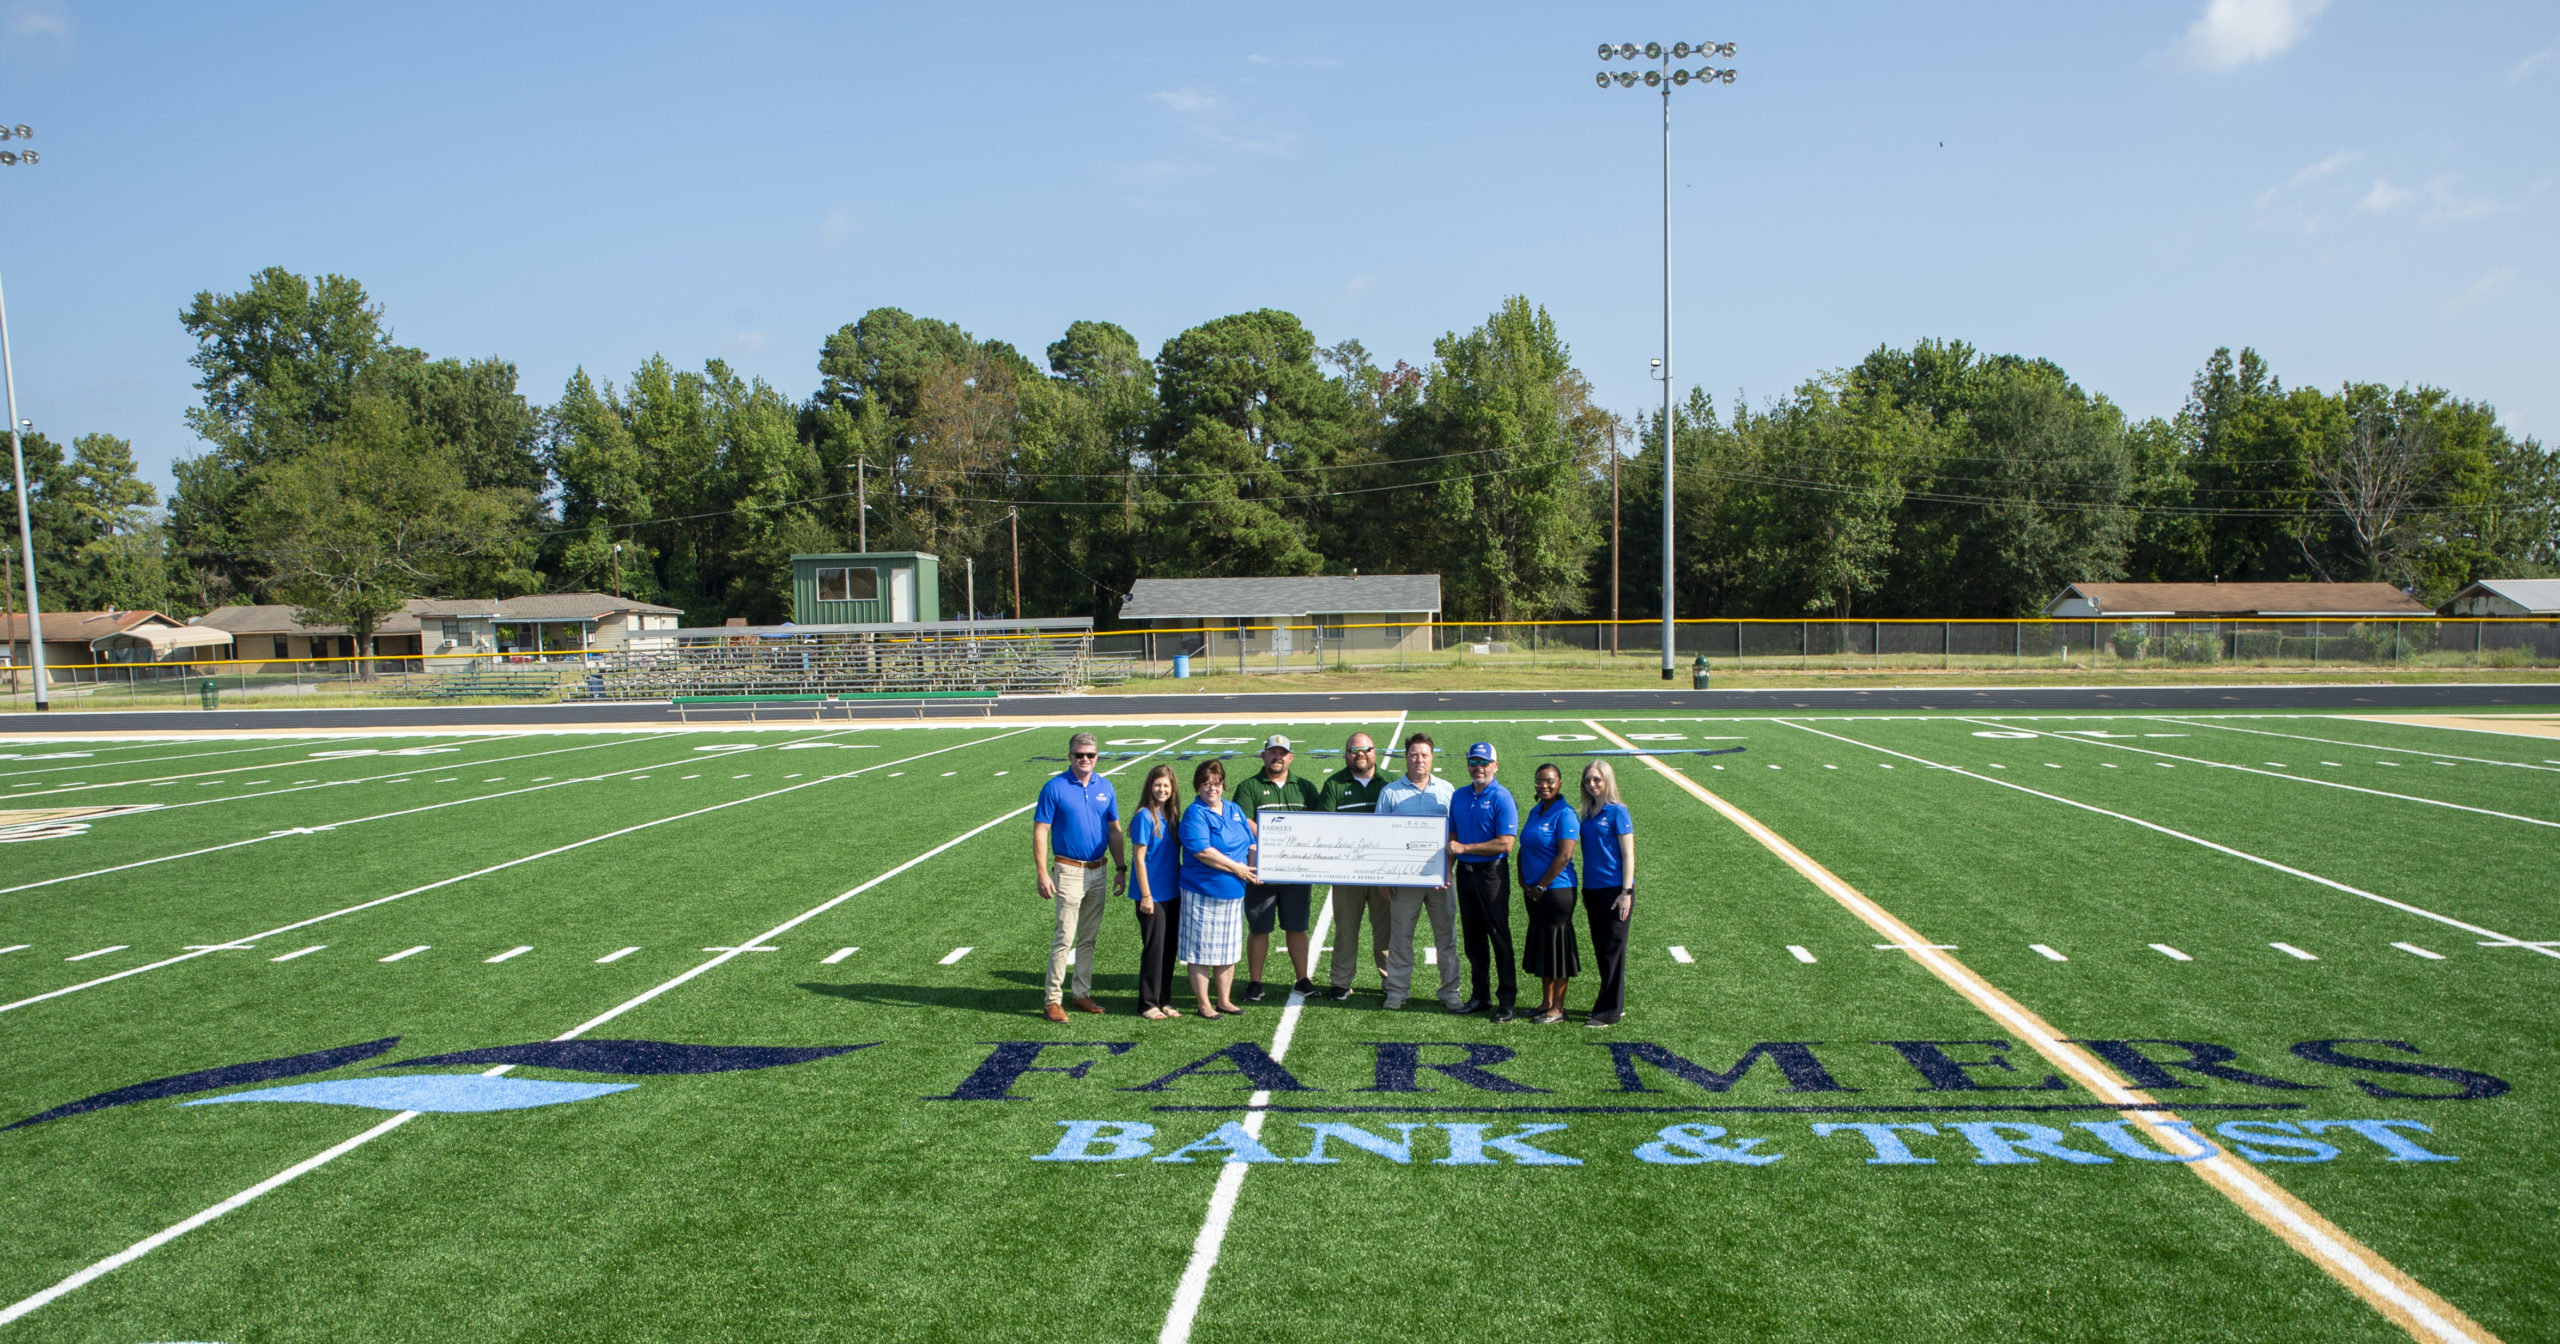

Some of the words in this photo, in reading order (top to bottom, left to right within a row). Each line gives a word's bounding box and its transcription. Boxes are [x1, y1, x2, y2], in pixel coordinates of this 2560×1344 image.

[922, 1039, 2511, 1101] FARMERS
[1030, 1119, 1584, 1167] BANK
[1631, 1121, 1784, 1167] &
[1811, 1119, 2461, 1165] TRUST
